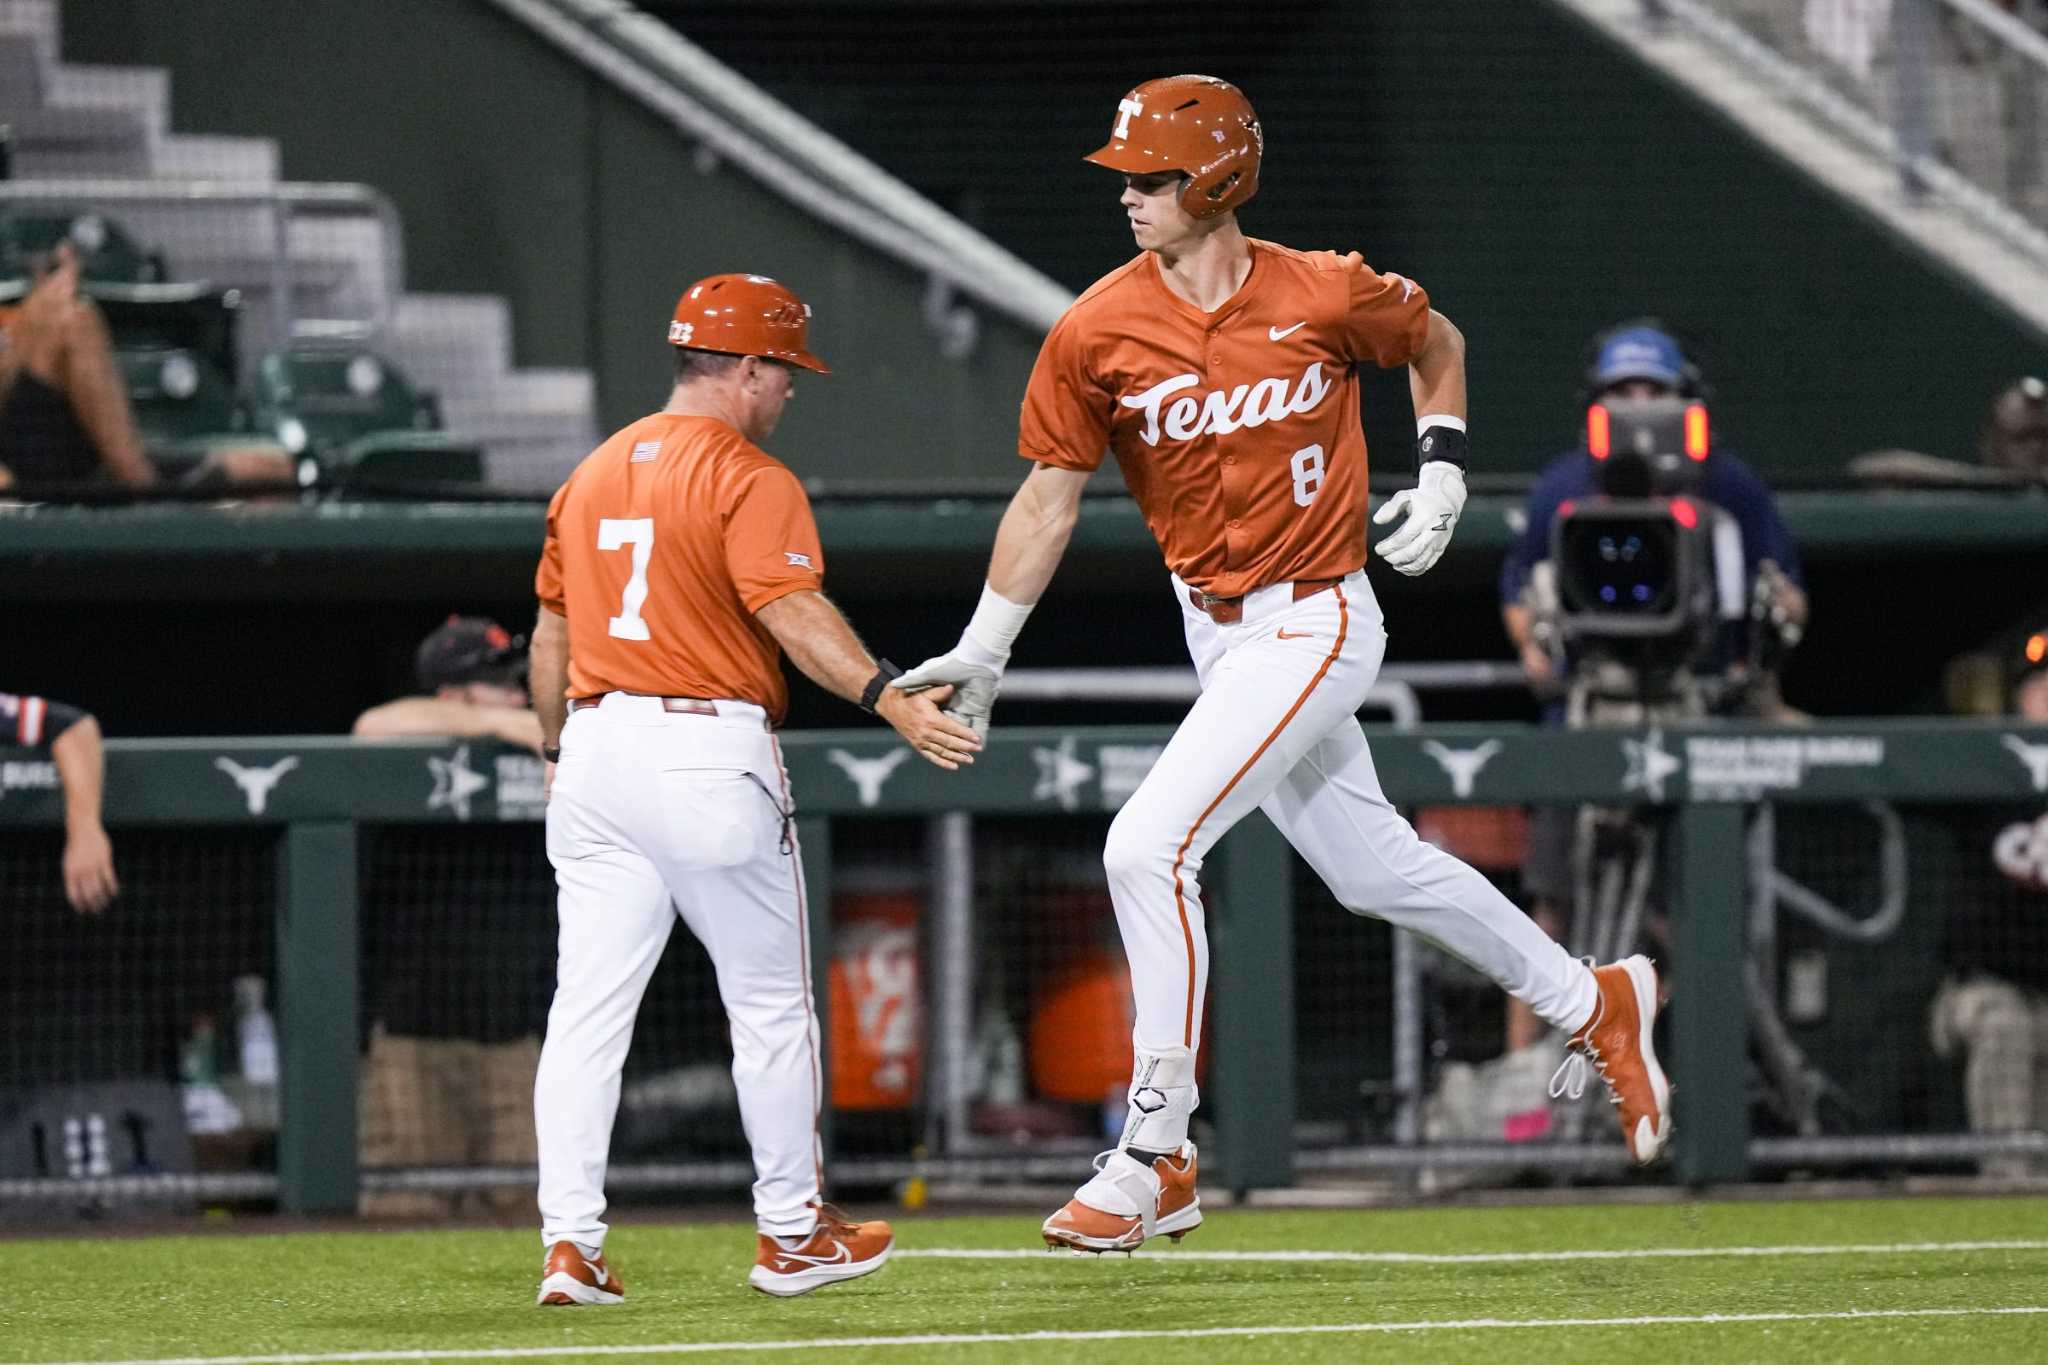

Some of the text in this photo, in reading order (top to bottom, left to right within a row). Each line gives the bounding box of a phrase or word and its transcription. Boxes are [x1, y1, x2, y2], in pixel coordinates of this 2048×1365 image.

[1114, 98, 1144, 140] T
[1121, 361, 1332, 447] Texas
[1290, 443, 1326, 508] 8
[597, 517, 654, 641] 7
